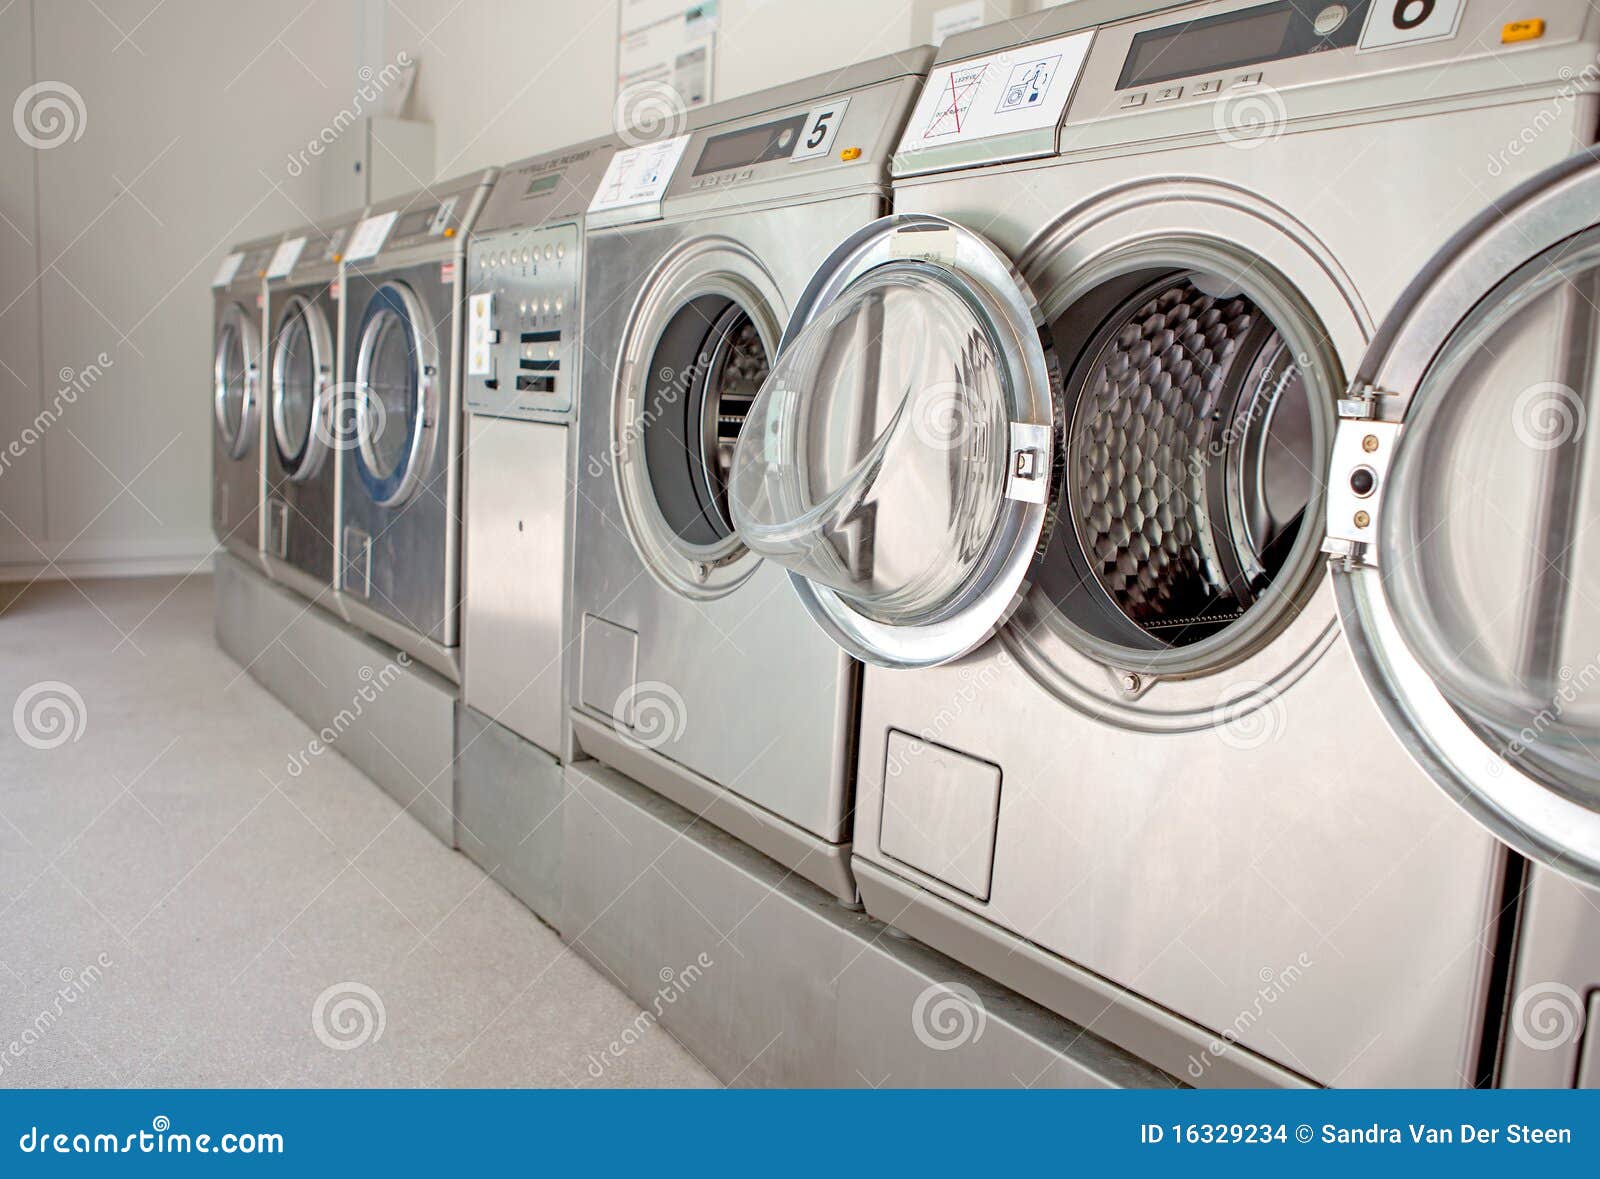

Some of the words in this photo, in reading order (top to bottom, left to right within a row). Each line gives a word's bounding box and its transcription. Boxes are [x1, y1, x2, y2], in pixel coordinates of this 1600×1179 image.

[1163, 88, 1173, 98] 2
[1201, 82, 1210, 92] 3
[807, 111, 834, 149] 5
